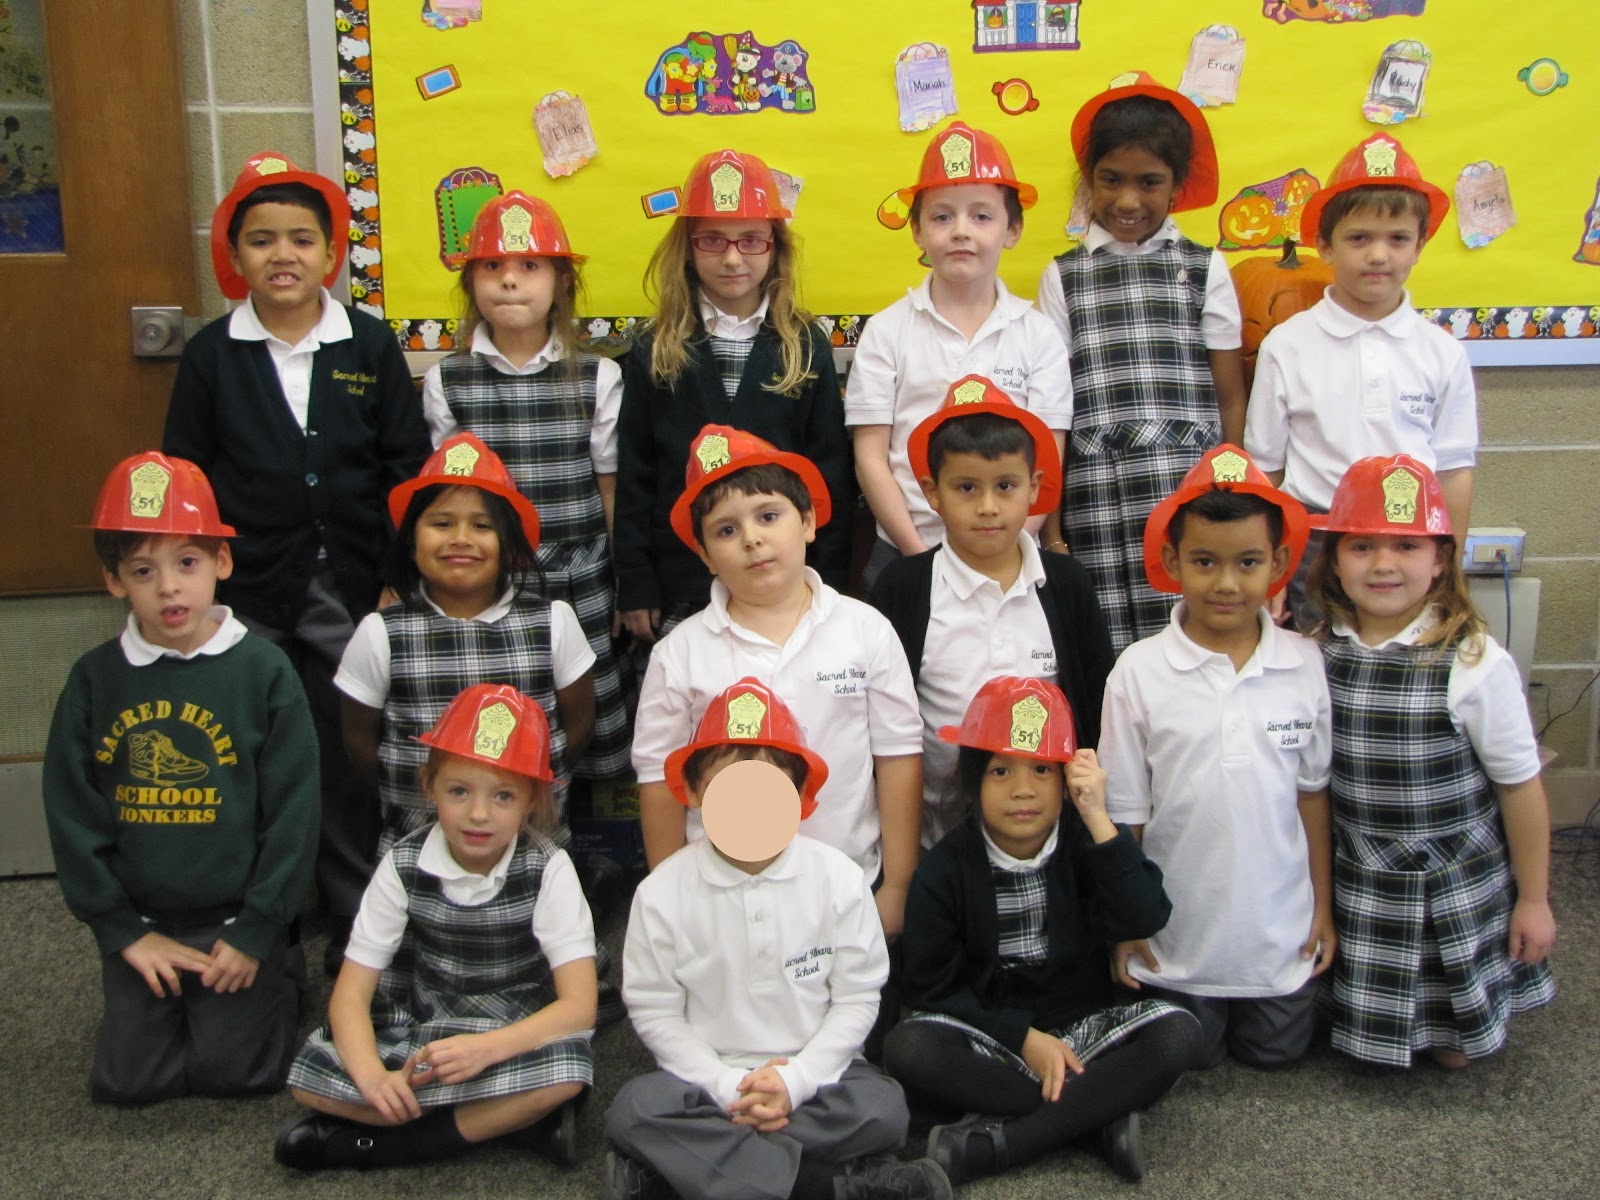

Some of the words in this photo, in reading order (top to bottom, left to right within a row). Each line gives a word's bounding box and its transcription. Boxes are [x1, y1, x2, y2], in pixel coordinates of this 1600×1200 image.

[1207, 58, 1237, 73] Erick
[912, 78, 946, 93] Mariah
[552, 124, 584, 141] Elias
[951, 161, 965, 173] 51
[1374, 167, 1388, 176] 51
[720, 194, 733, 205] 51
[510, 234, 523, 245] 51
[710, 457, 724, 470] 51
[451, 467, 466, 476] 51
[139, 497, 156, 510] 51
[1392, 503, 1408, 516] 51
[816, 669, 847, 682] Sacred
[96, 700, 172, 764] SACRED
[178, 702, 238, 766] HEART
[736, 723, 752, 735] 51
[481, 736, 500, 751] 51
[1018, 730, 1034, 744] 51
[115, 784, 222, 806] SCHOOL
[784, 952, 808, 968] acred
[794, 961, 821, 979] School
